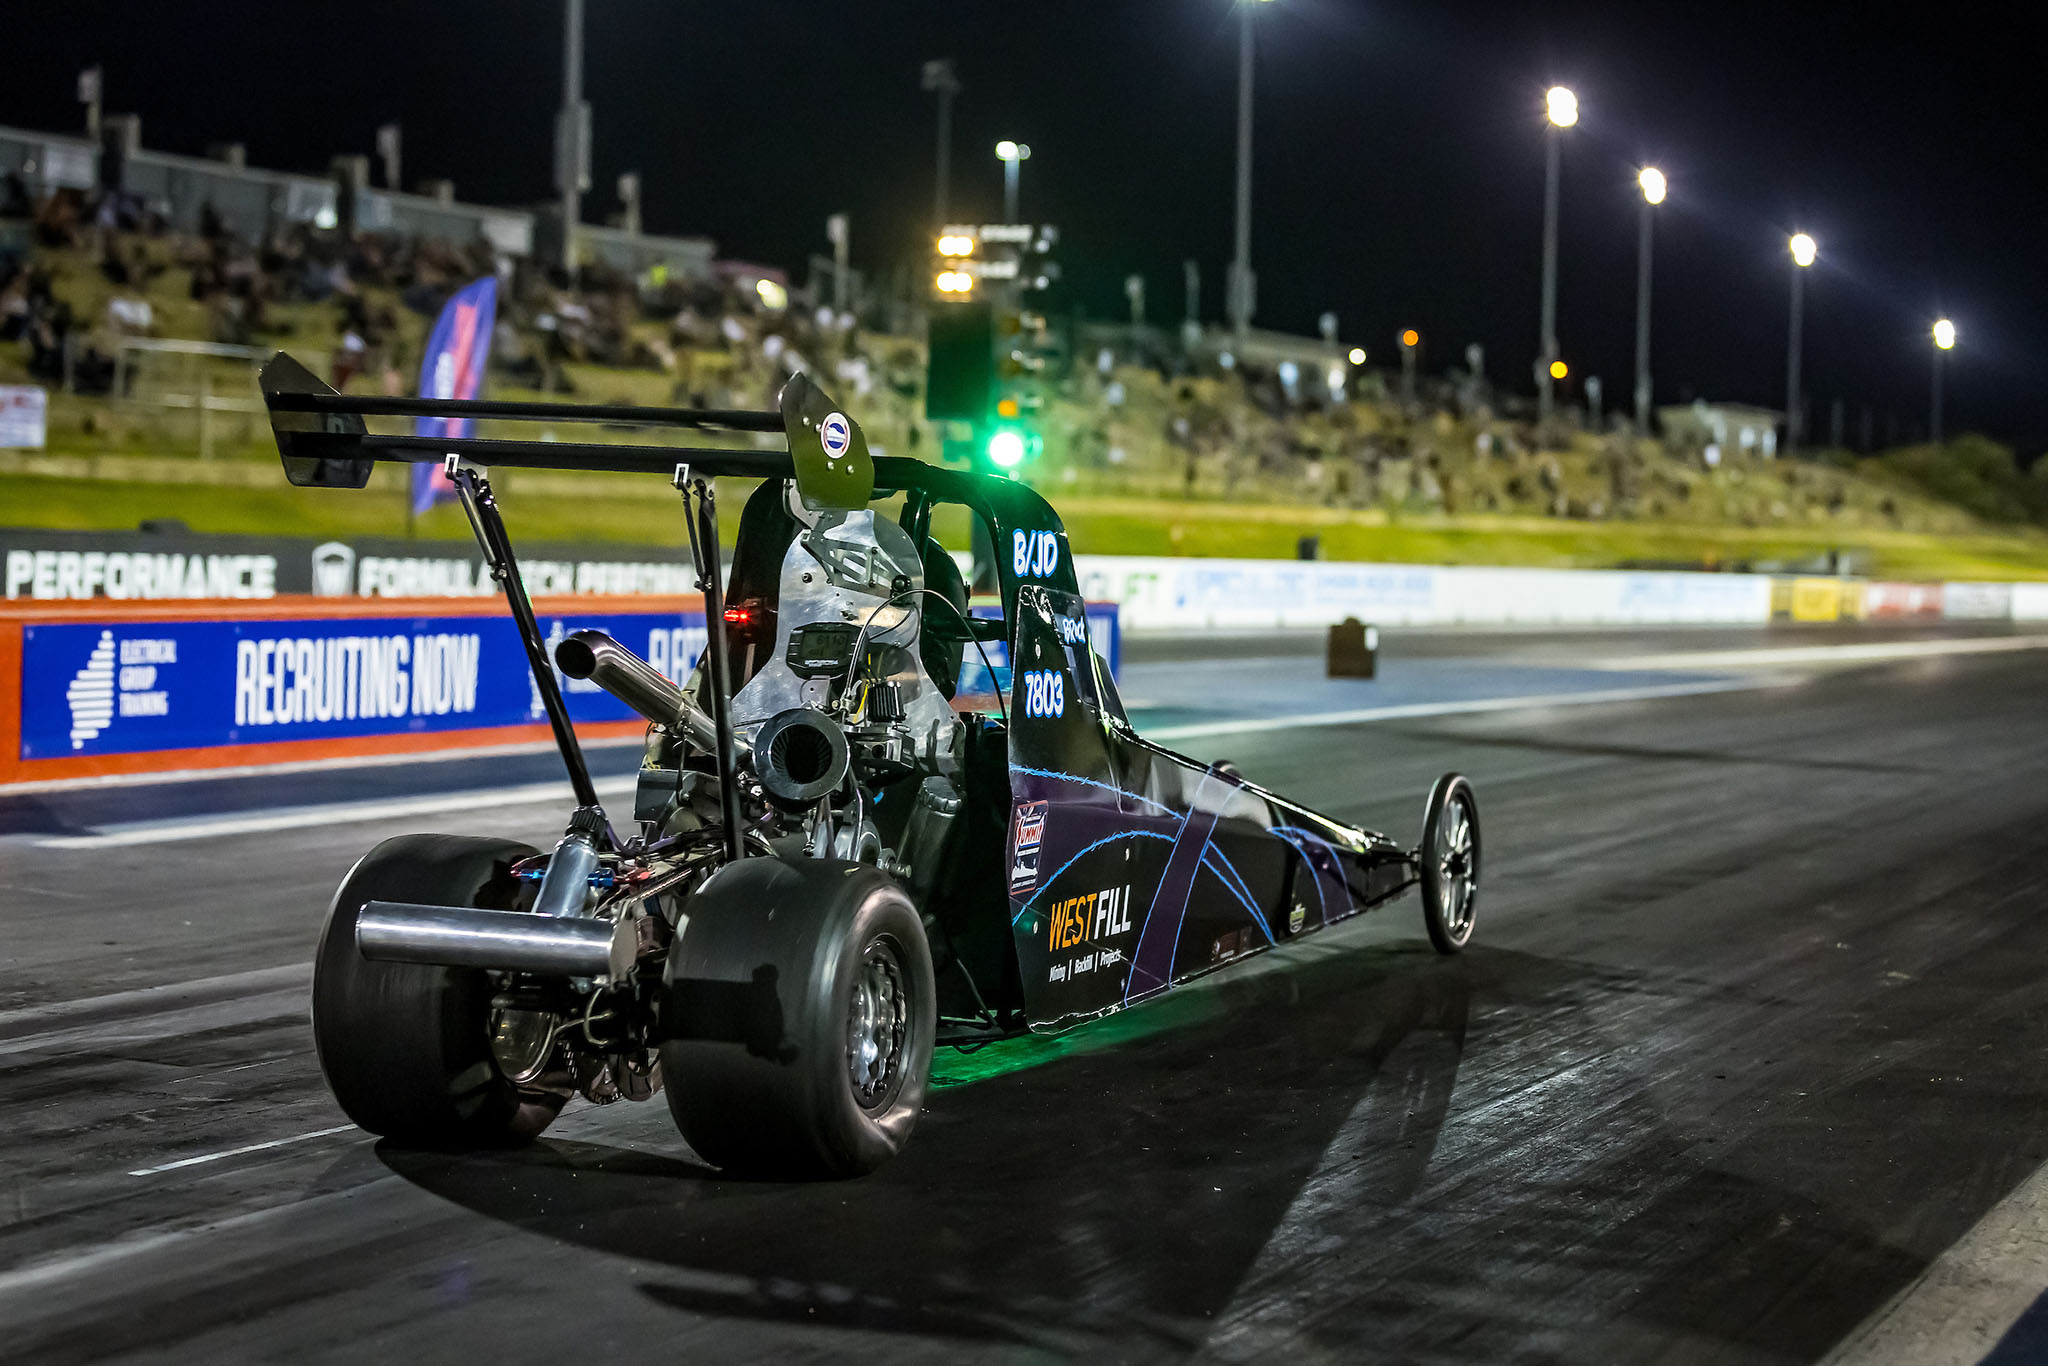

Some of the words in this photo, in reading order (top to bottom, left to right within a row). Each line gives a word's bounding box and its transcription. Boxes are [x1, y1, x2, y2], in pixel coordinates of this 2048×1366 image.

[6, 550, 277, 600] PERFORMANCE
[1012, 528, 1058, 579] B/JD
[234, 637, 410, 726] RECRUITING
[411, 633, 480, 715] NOW
[1024, 669, 1065, 719] 7803
